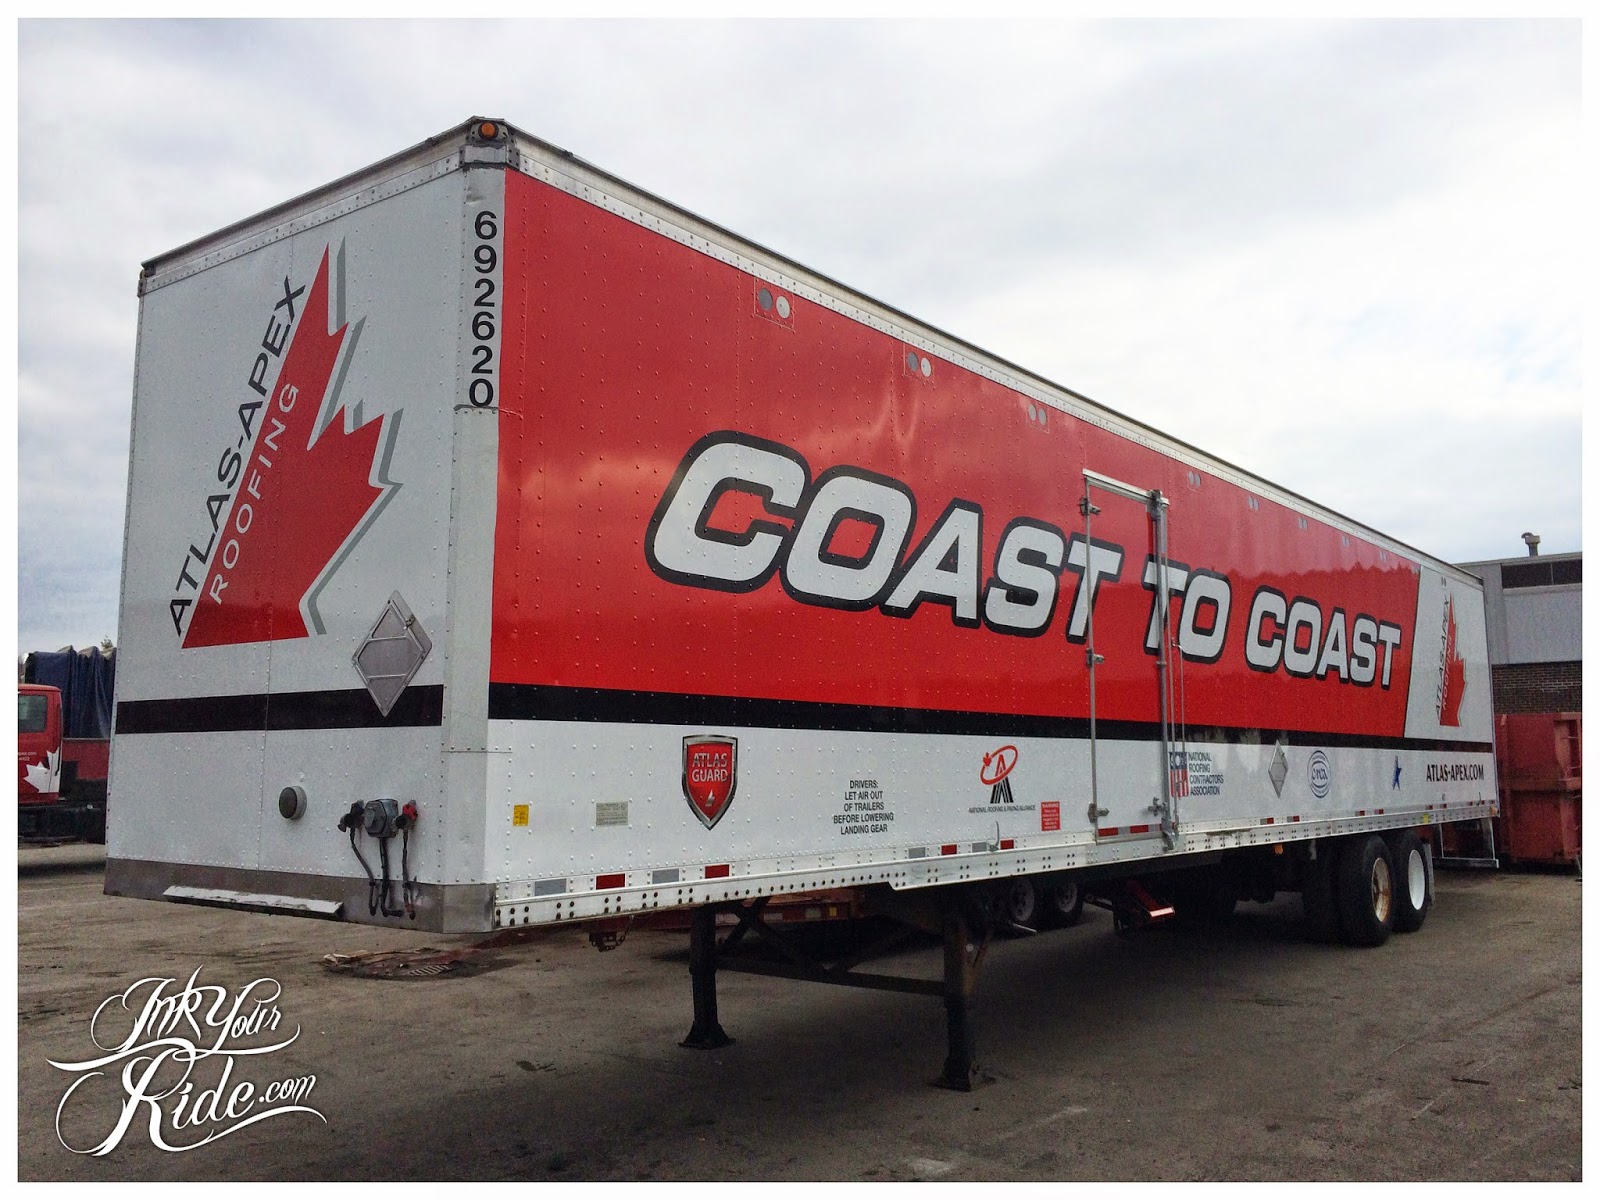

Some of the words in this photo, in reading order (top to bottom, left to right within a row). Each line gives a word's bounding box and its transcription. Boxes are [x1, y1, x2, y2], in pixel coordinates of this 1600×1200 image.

[468, 210, 499, 408] 692620
[169, 275, 306, 636] ATLAS-APEX
[209, 382, 299, 604] ROOFING
[645, 430, 1124, 644] COAST
[1143, 554, 1231, 664] TO
[1244, 584, 1402, 690] COAST
[692, 753, 728, 767] ATLAS
[1188, 752, 1211, 761] NATIONAL
[1189, 763, 1210, 773] ROOFING
[1426, 764, 1485, 782] ATLAS-APEX.COM
[691, 769, 728, 781] GUARD
[1190, 774, 1224, 784] CONTRACTORS
[849, 780, 879, 789] DRIVERS:
[844, 791, 857, 801] LET
[857, 791, 869, 800] AIR
[870, 790, 883, 800] OUT
[1190, 786, 1220, 796] ASSOCIATION
[843, 802, 853, 812] OF
[854, 802, 885, 811] TRAILERS
[833, 814, 860, 824] BEFORE
[860, 812, 895, 822] LOWERING
[840, 825, 870, 835] LANDING
[870, 824, 888, 833] GEAR
